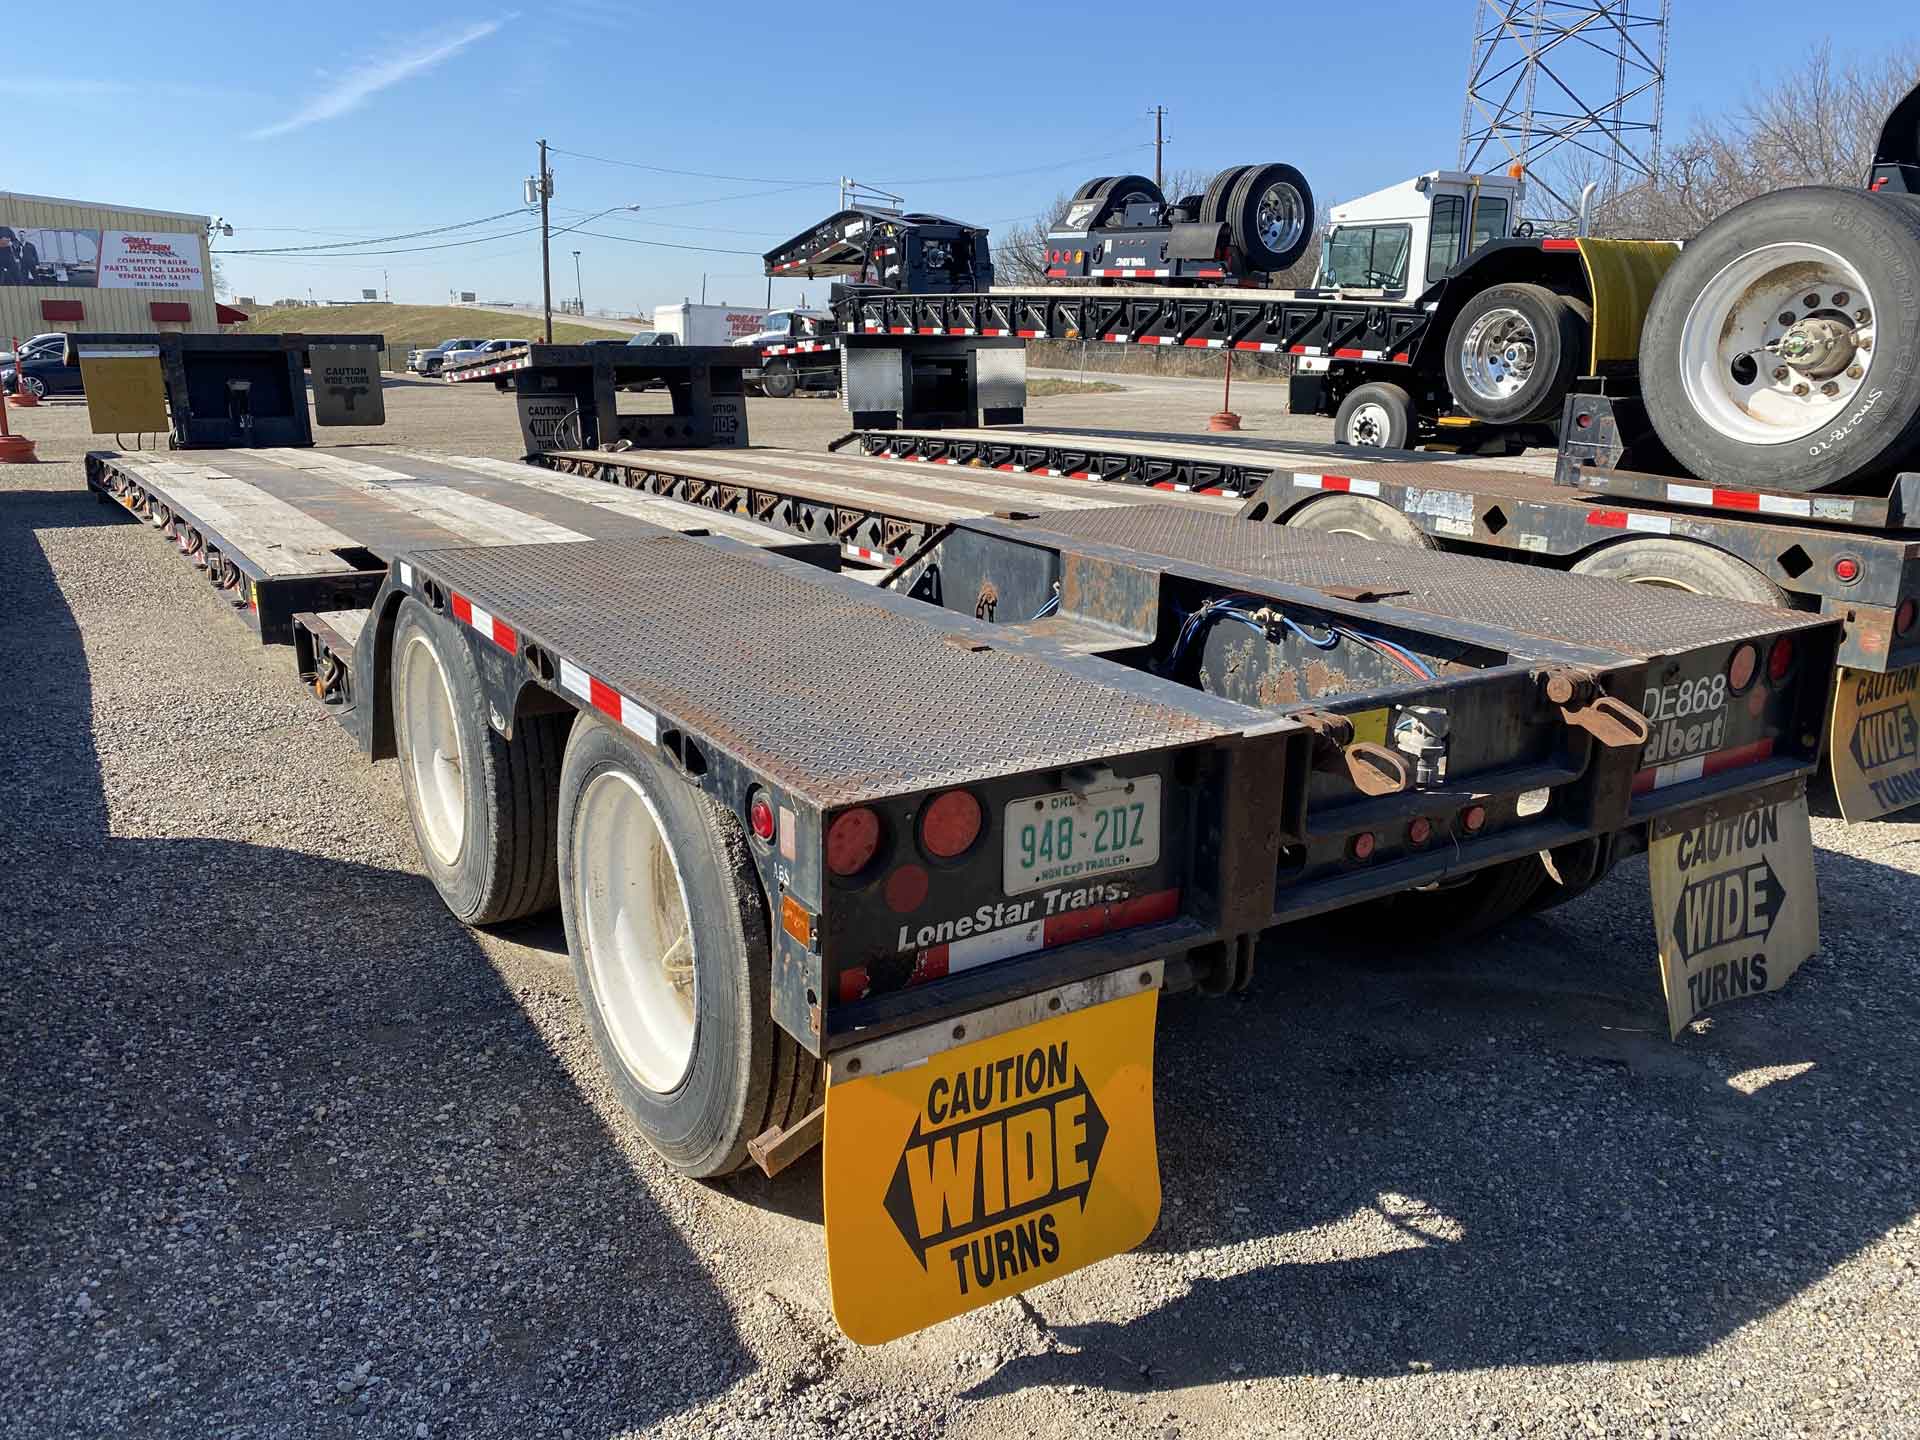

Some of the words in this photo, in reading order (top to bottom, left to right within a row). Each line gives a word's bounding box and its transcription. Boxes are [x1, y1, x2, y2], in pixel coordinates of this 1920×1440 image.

[326, 367, 367, 376] CAUTION
[1856, 667, 1920, 706] CAUTION
[1860, 706, 1915, 768] WIDE
[1085, 855, 1125, 871] TRAILER
[1677, 804, 1779, 872] CAUTION
[897, 898, 1035, 953] LoneStar
[1685, 865, 1770, 955] WIDE
[1687, 952, 1768, 1016] TURNS
[927, 1040, 1069, 1125] CAUTION
[905, 1093, 1090, 1240] WIDE
[950, 1213, 1060, 1296] TURNS
